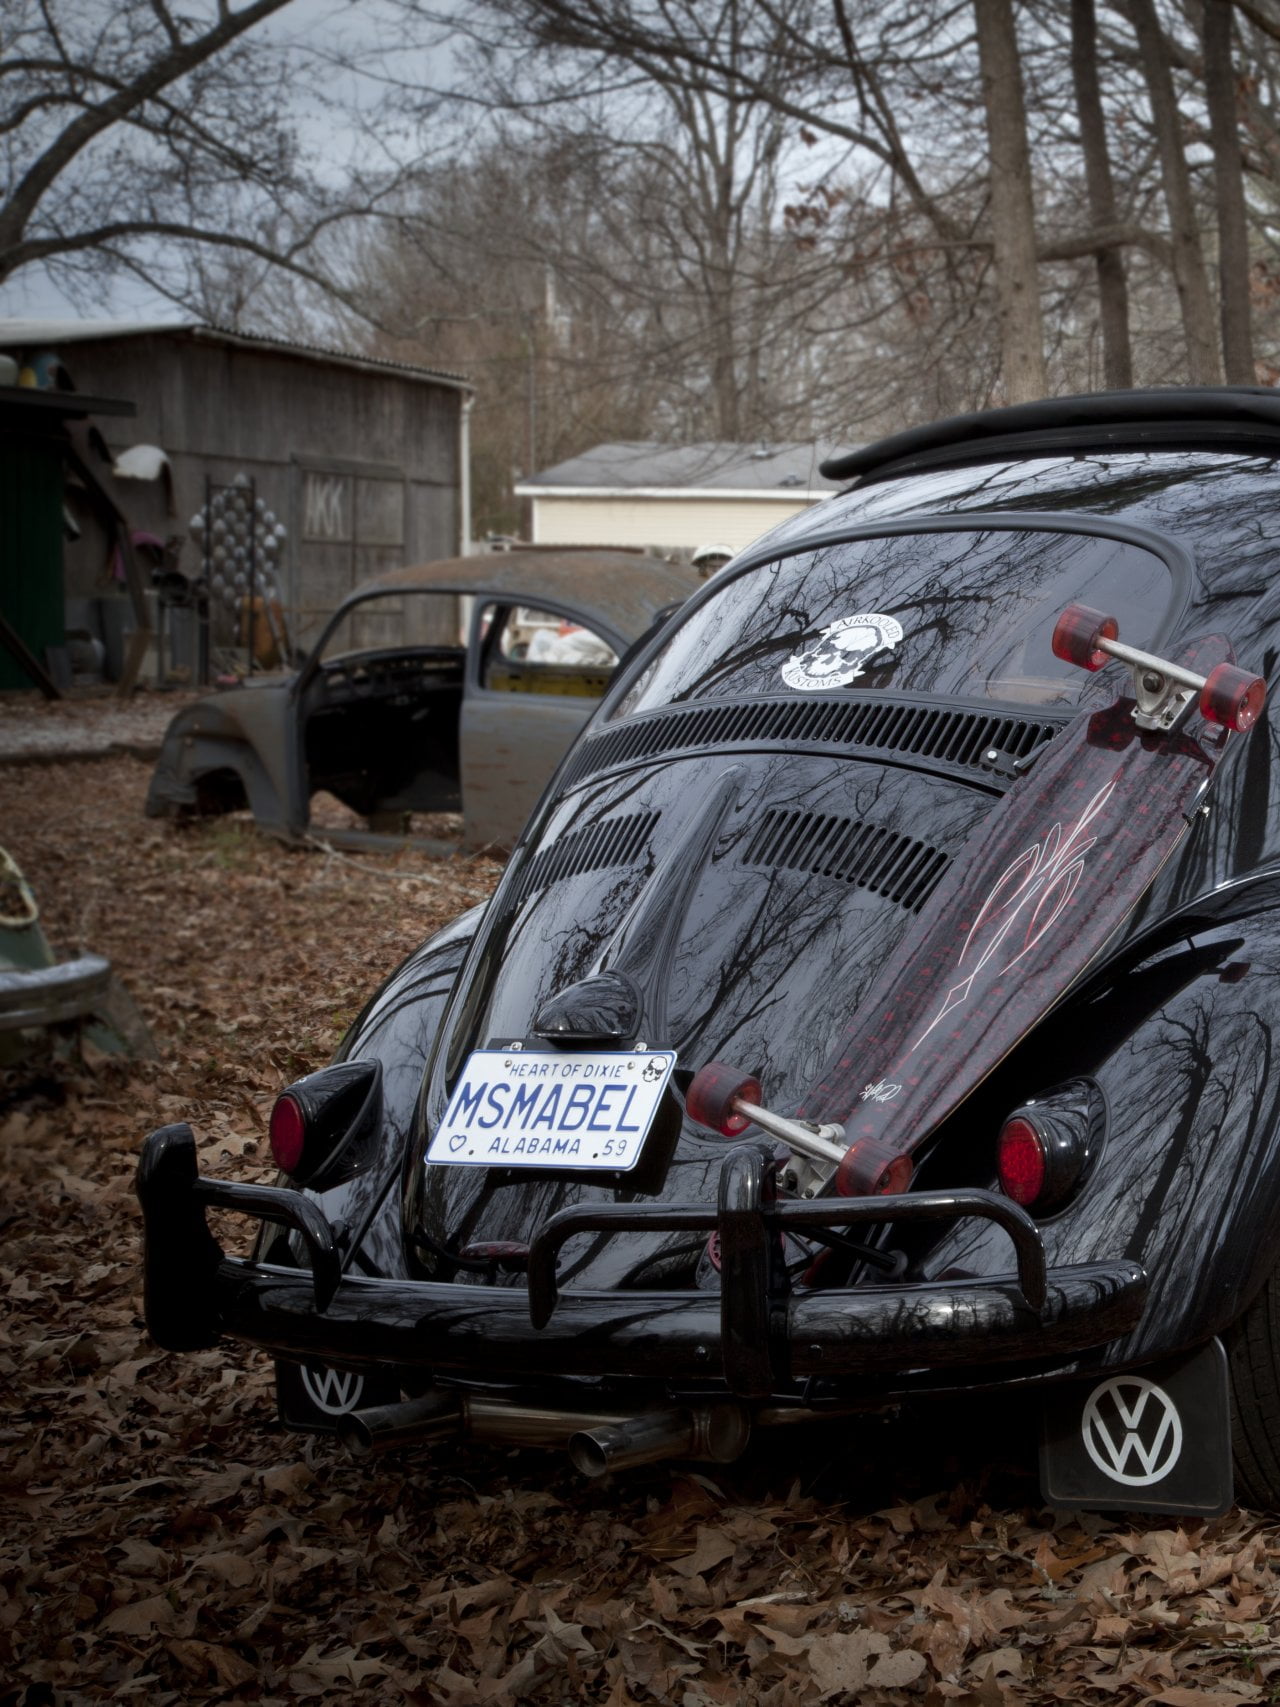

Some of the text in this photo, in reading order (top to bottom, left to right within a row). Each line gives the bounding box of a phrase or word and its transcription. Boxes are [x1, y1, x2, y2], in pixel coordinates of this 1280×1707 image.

[836, 614, 900, 639] AIRKOOLED
[784, 667, 842, 688] KUSTOMS
[510, 1063, 625, 1078] HEART OF DIXIE
[447, 1082, 641, 1132] MSMABEL
[488, 1137, 628, 1156] ALABAMA 59
[1085, 1379, 1179, 1482] VW
